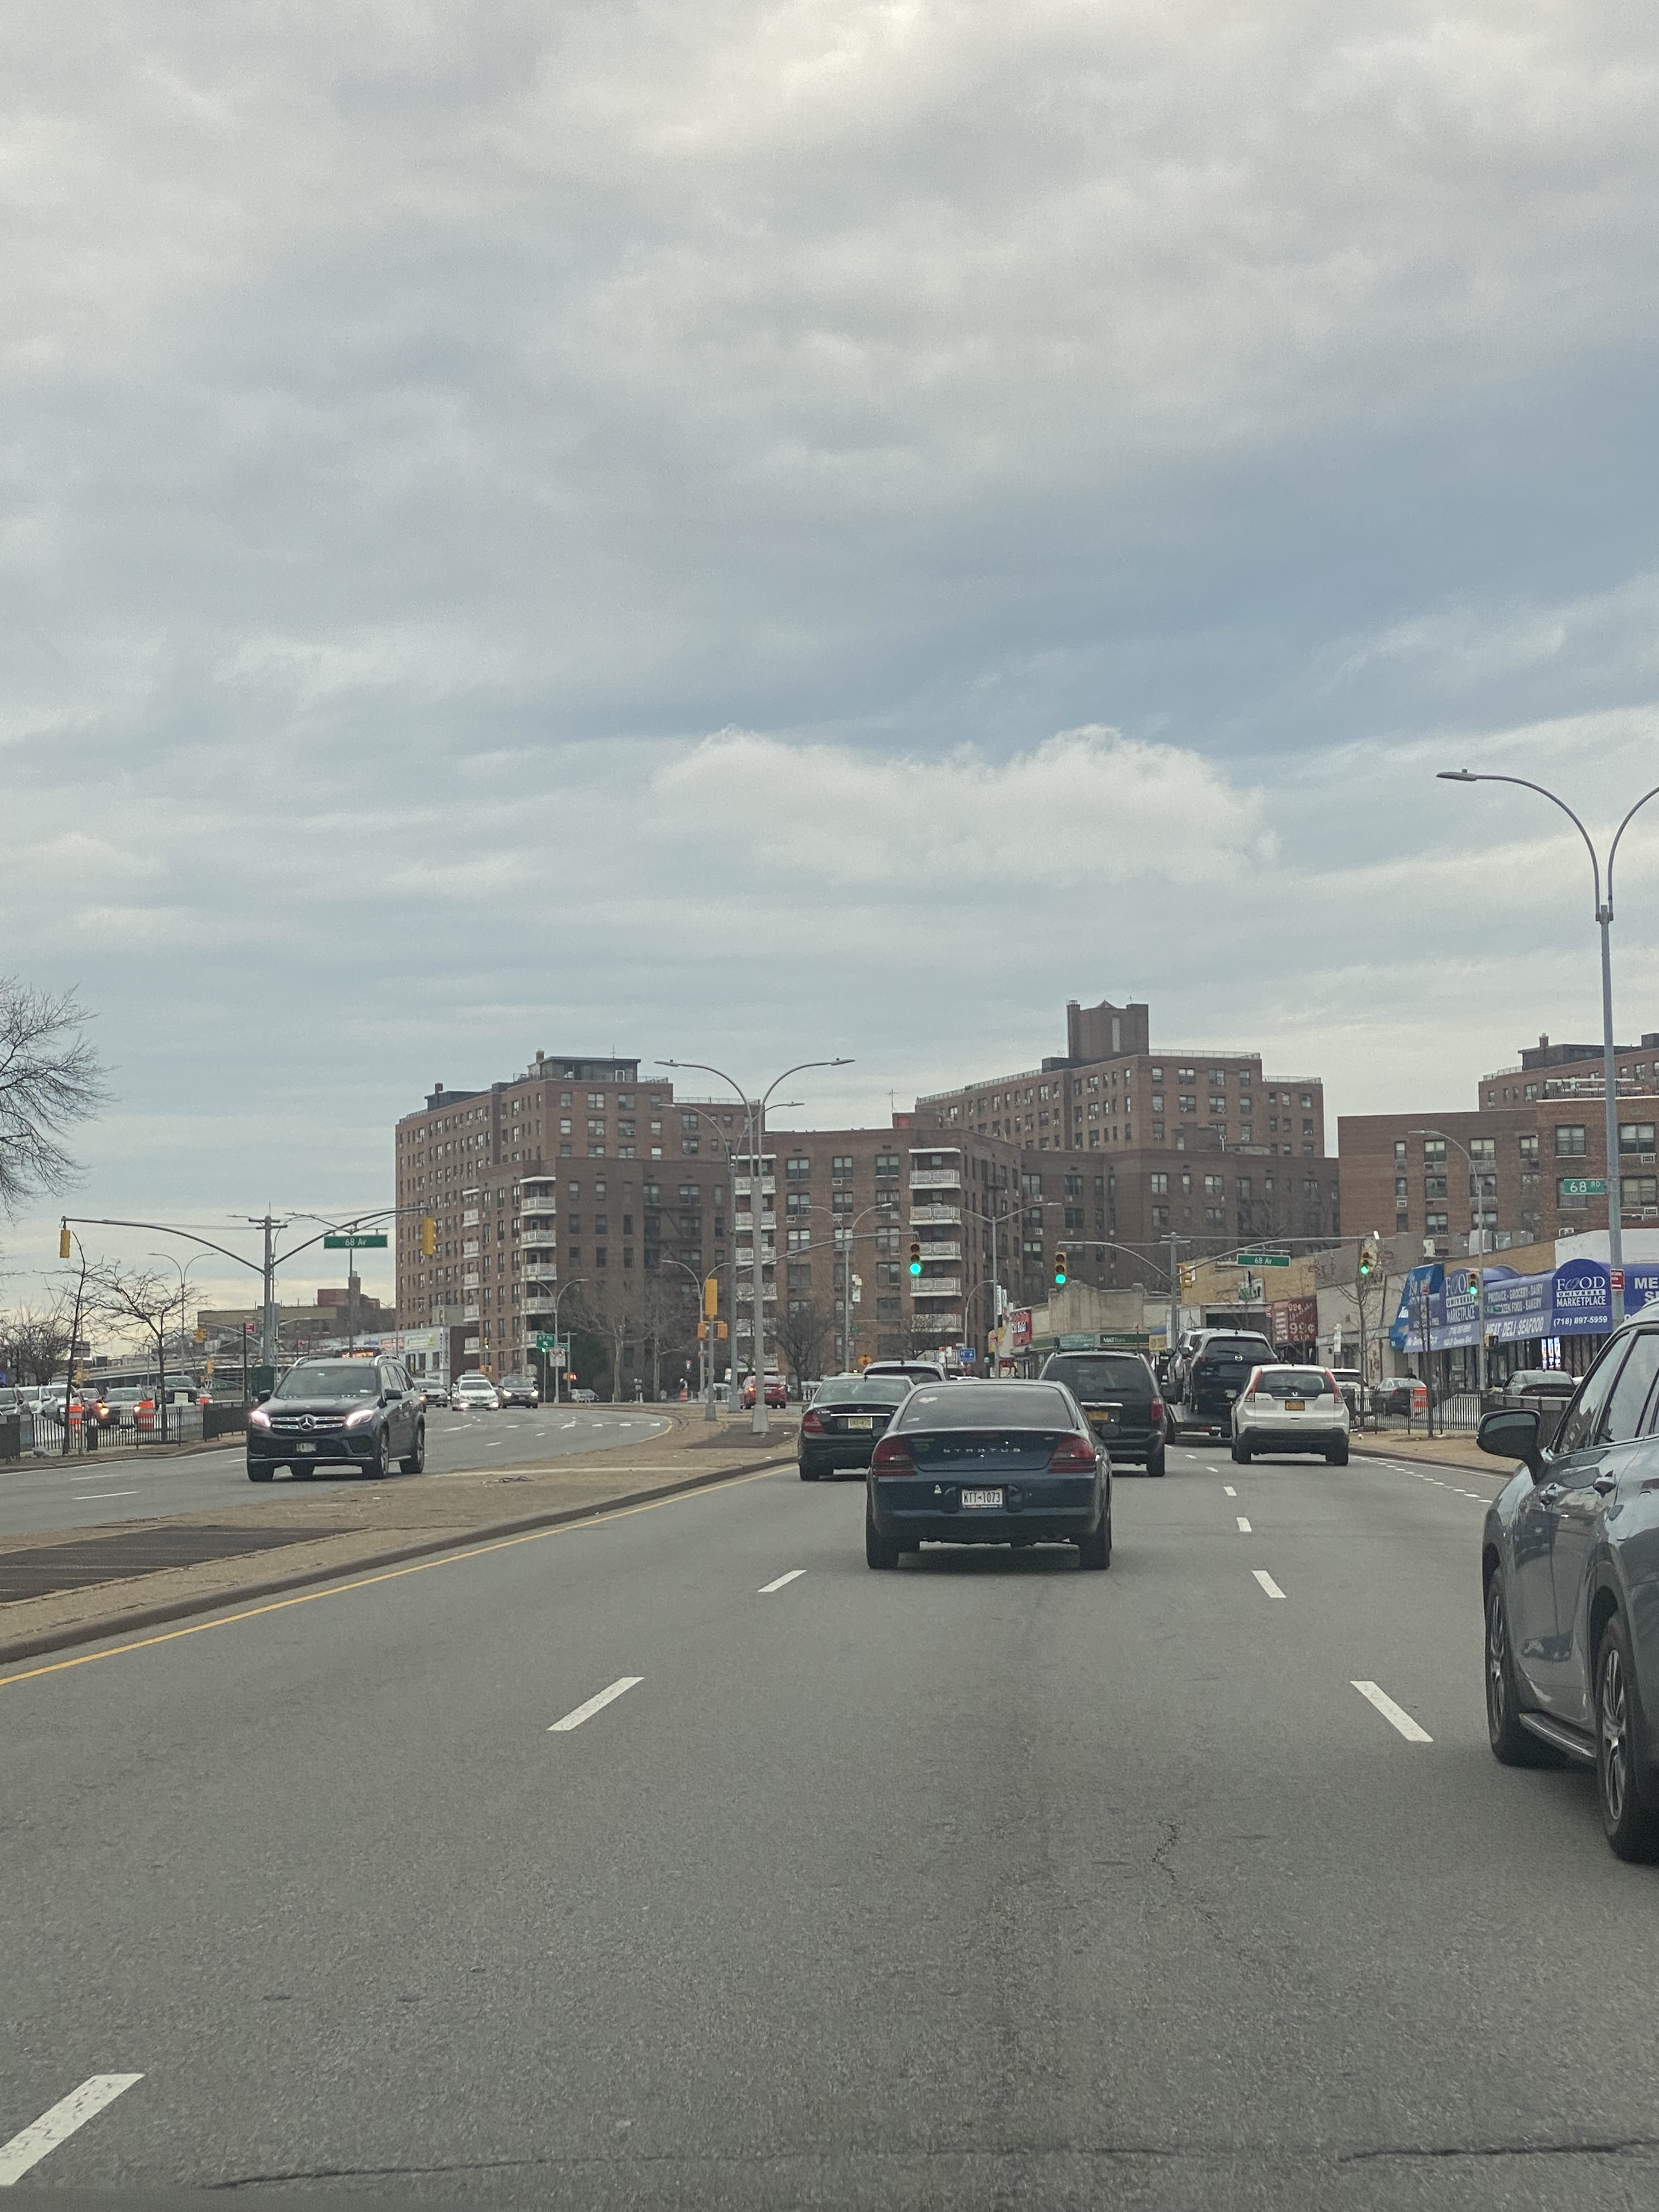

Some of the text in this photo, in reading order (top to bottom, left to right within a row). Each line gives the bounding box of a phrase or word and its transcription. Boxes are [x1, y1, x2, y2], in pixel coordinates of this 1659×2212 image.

[1570, 1181, 1587, 1192] 68
[345, 1238, 366, 1246] 68 Av
[1446, 1273, 1470, 1296] FOO
[1557, 1276, 1605, 1290] FOOD
[1487, 1290, 1507, 1304] PRODUCE
[1509, 1286, 1528, 1300] GROCERY
[1556, 1296, 1606, 1307] MARKETPLACE
[1525, 1297, 1542, 1310] BAKERY
[1447, 1304, 1475, 1324] MARKETPLACE
[1502, 1320, 1517, 1337] DELI
[1517, 1316, 1544, 1335] SEAFOOD
[1554, 1316, 1607, 1327] (718) 897-5959
